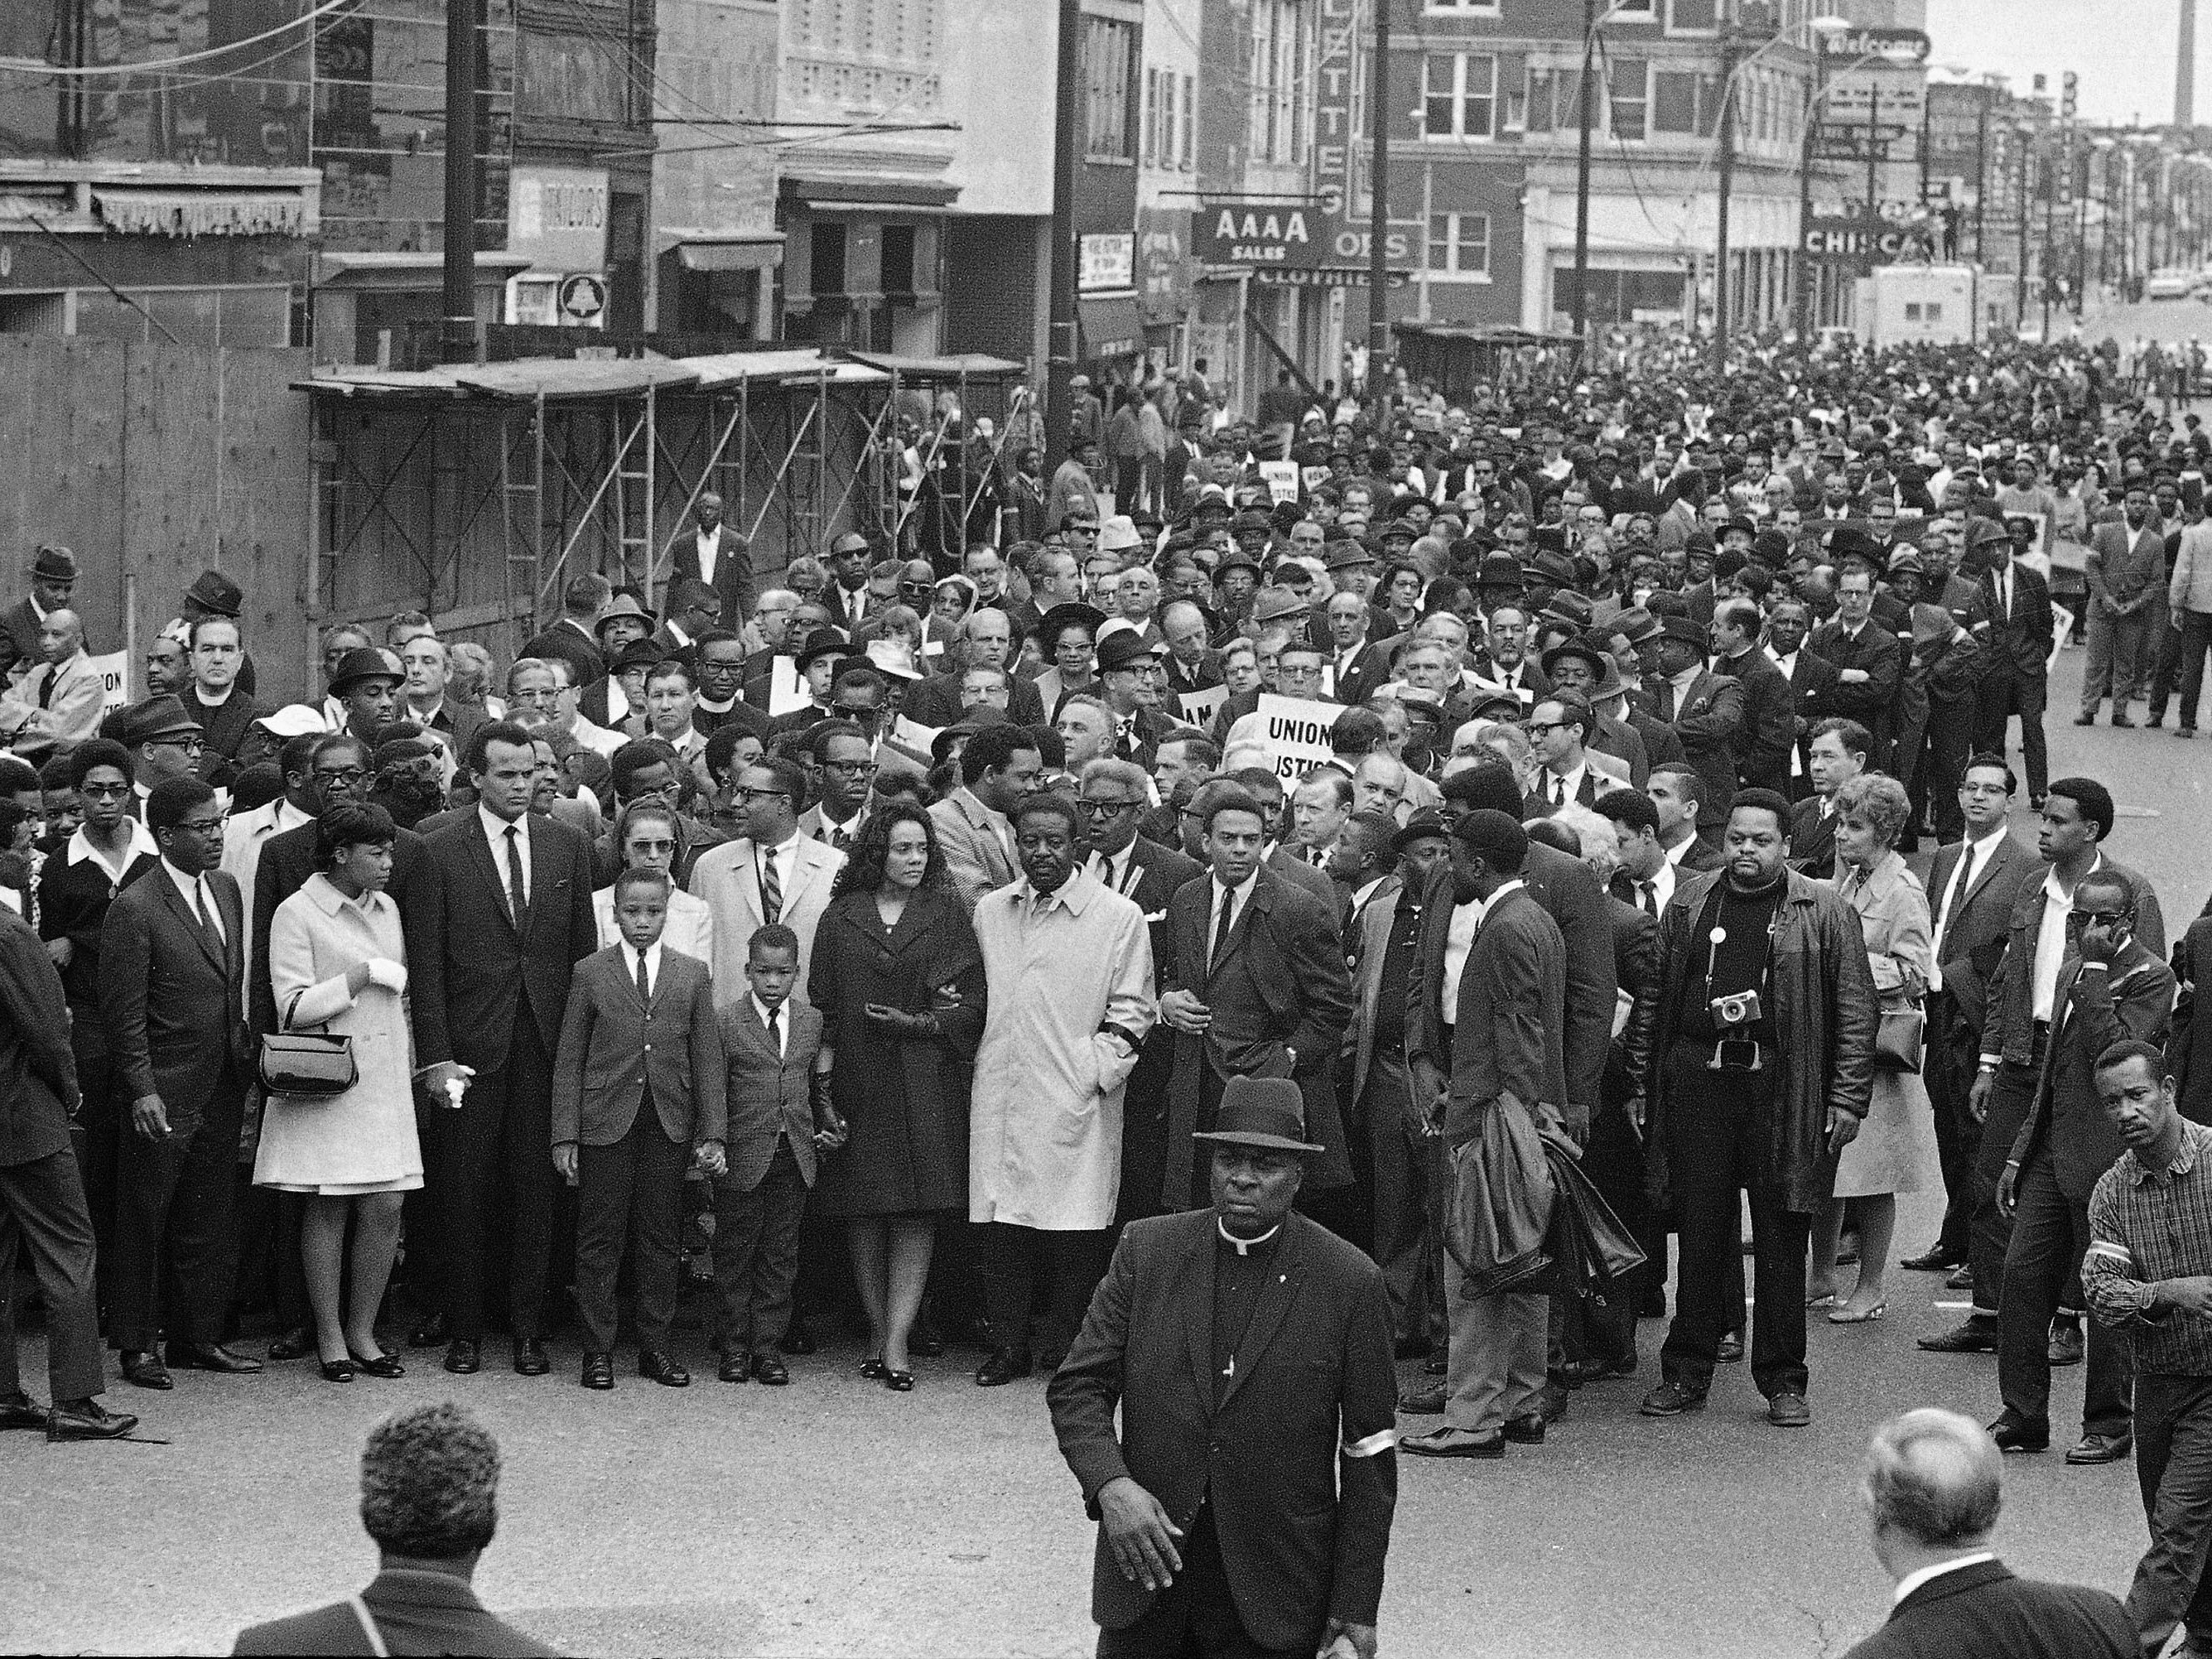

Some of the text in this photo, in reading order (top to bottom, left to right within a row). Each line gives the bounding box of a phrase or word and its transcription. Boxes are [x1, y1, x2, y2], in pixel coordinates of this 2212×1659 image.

[1216, 209, 1309, 243] AAAA
[1231, 246, 1286, 260] SALES
[1257, 270, 1404, 288] CLOTHIES
[100, 672, 122, 692] ON
[1269, 716, 1333, 747] UNION
